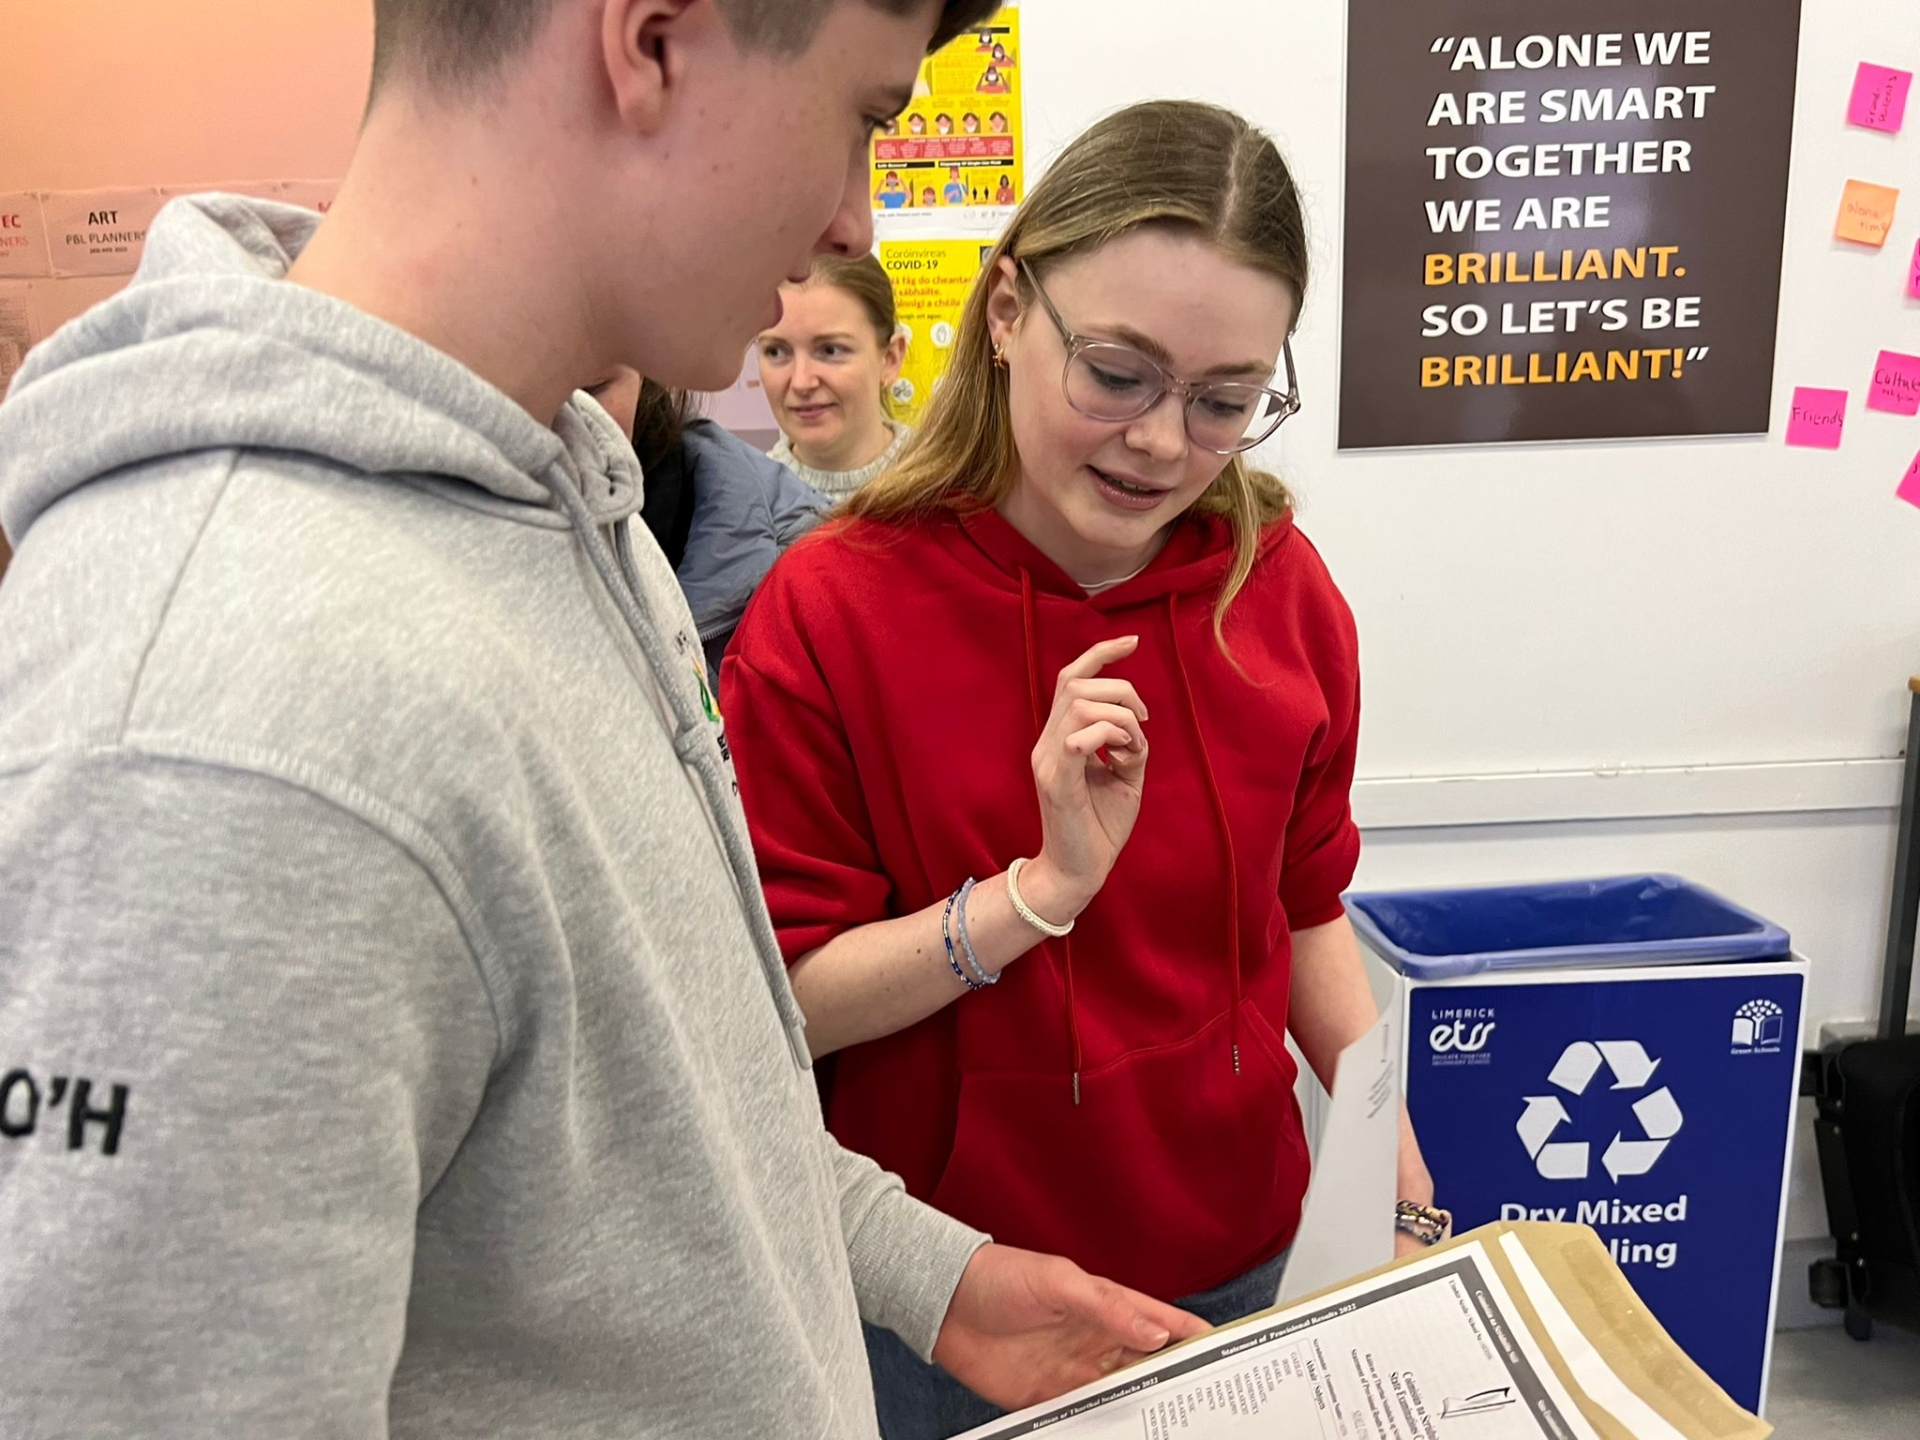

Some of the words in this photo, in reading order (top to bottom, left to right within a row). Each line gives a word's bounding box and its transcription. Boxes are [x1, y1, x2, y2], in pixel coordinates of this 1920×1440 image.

[1634, 31, 1711, 66] WE
[1427, 90, 1526, 126] ARE
[1539, 85, 1717, 123] SMART
[1426, 139, 1692, 180] TOGETHER
[88, 210, 118, 225] ART
[1424, 199, 1501, 233] WE
[1513, 195, 1610, 231] ARE
[0, 236, 29, 248] NERS
[65, 234, 87, 246] PBL
[886, 260, 938, 270] COVID-19
[1424, 245, 1686, 286] BRILLIANT.
[1421, 303, 1488, 338] SO
[1642, 296, 1700, 330] BE
[1792, 407, 1843, 427] Friends
[1431, 1008, 1495, 1020] LIMERICK
[1576, 1194, 1688, 1225] Mixed
[1610, 1238, 1678, 1269] ling
[1221, 1338, 1257, 1355] Statement
